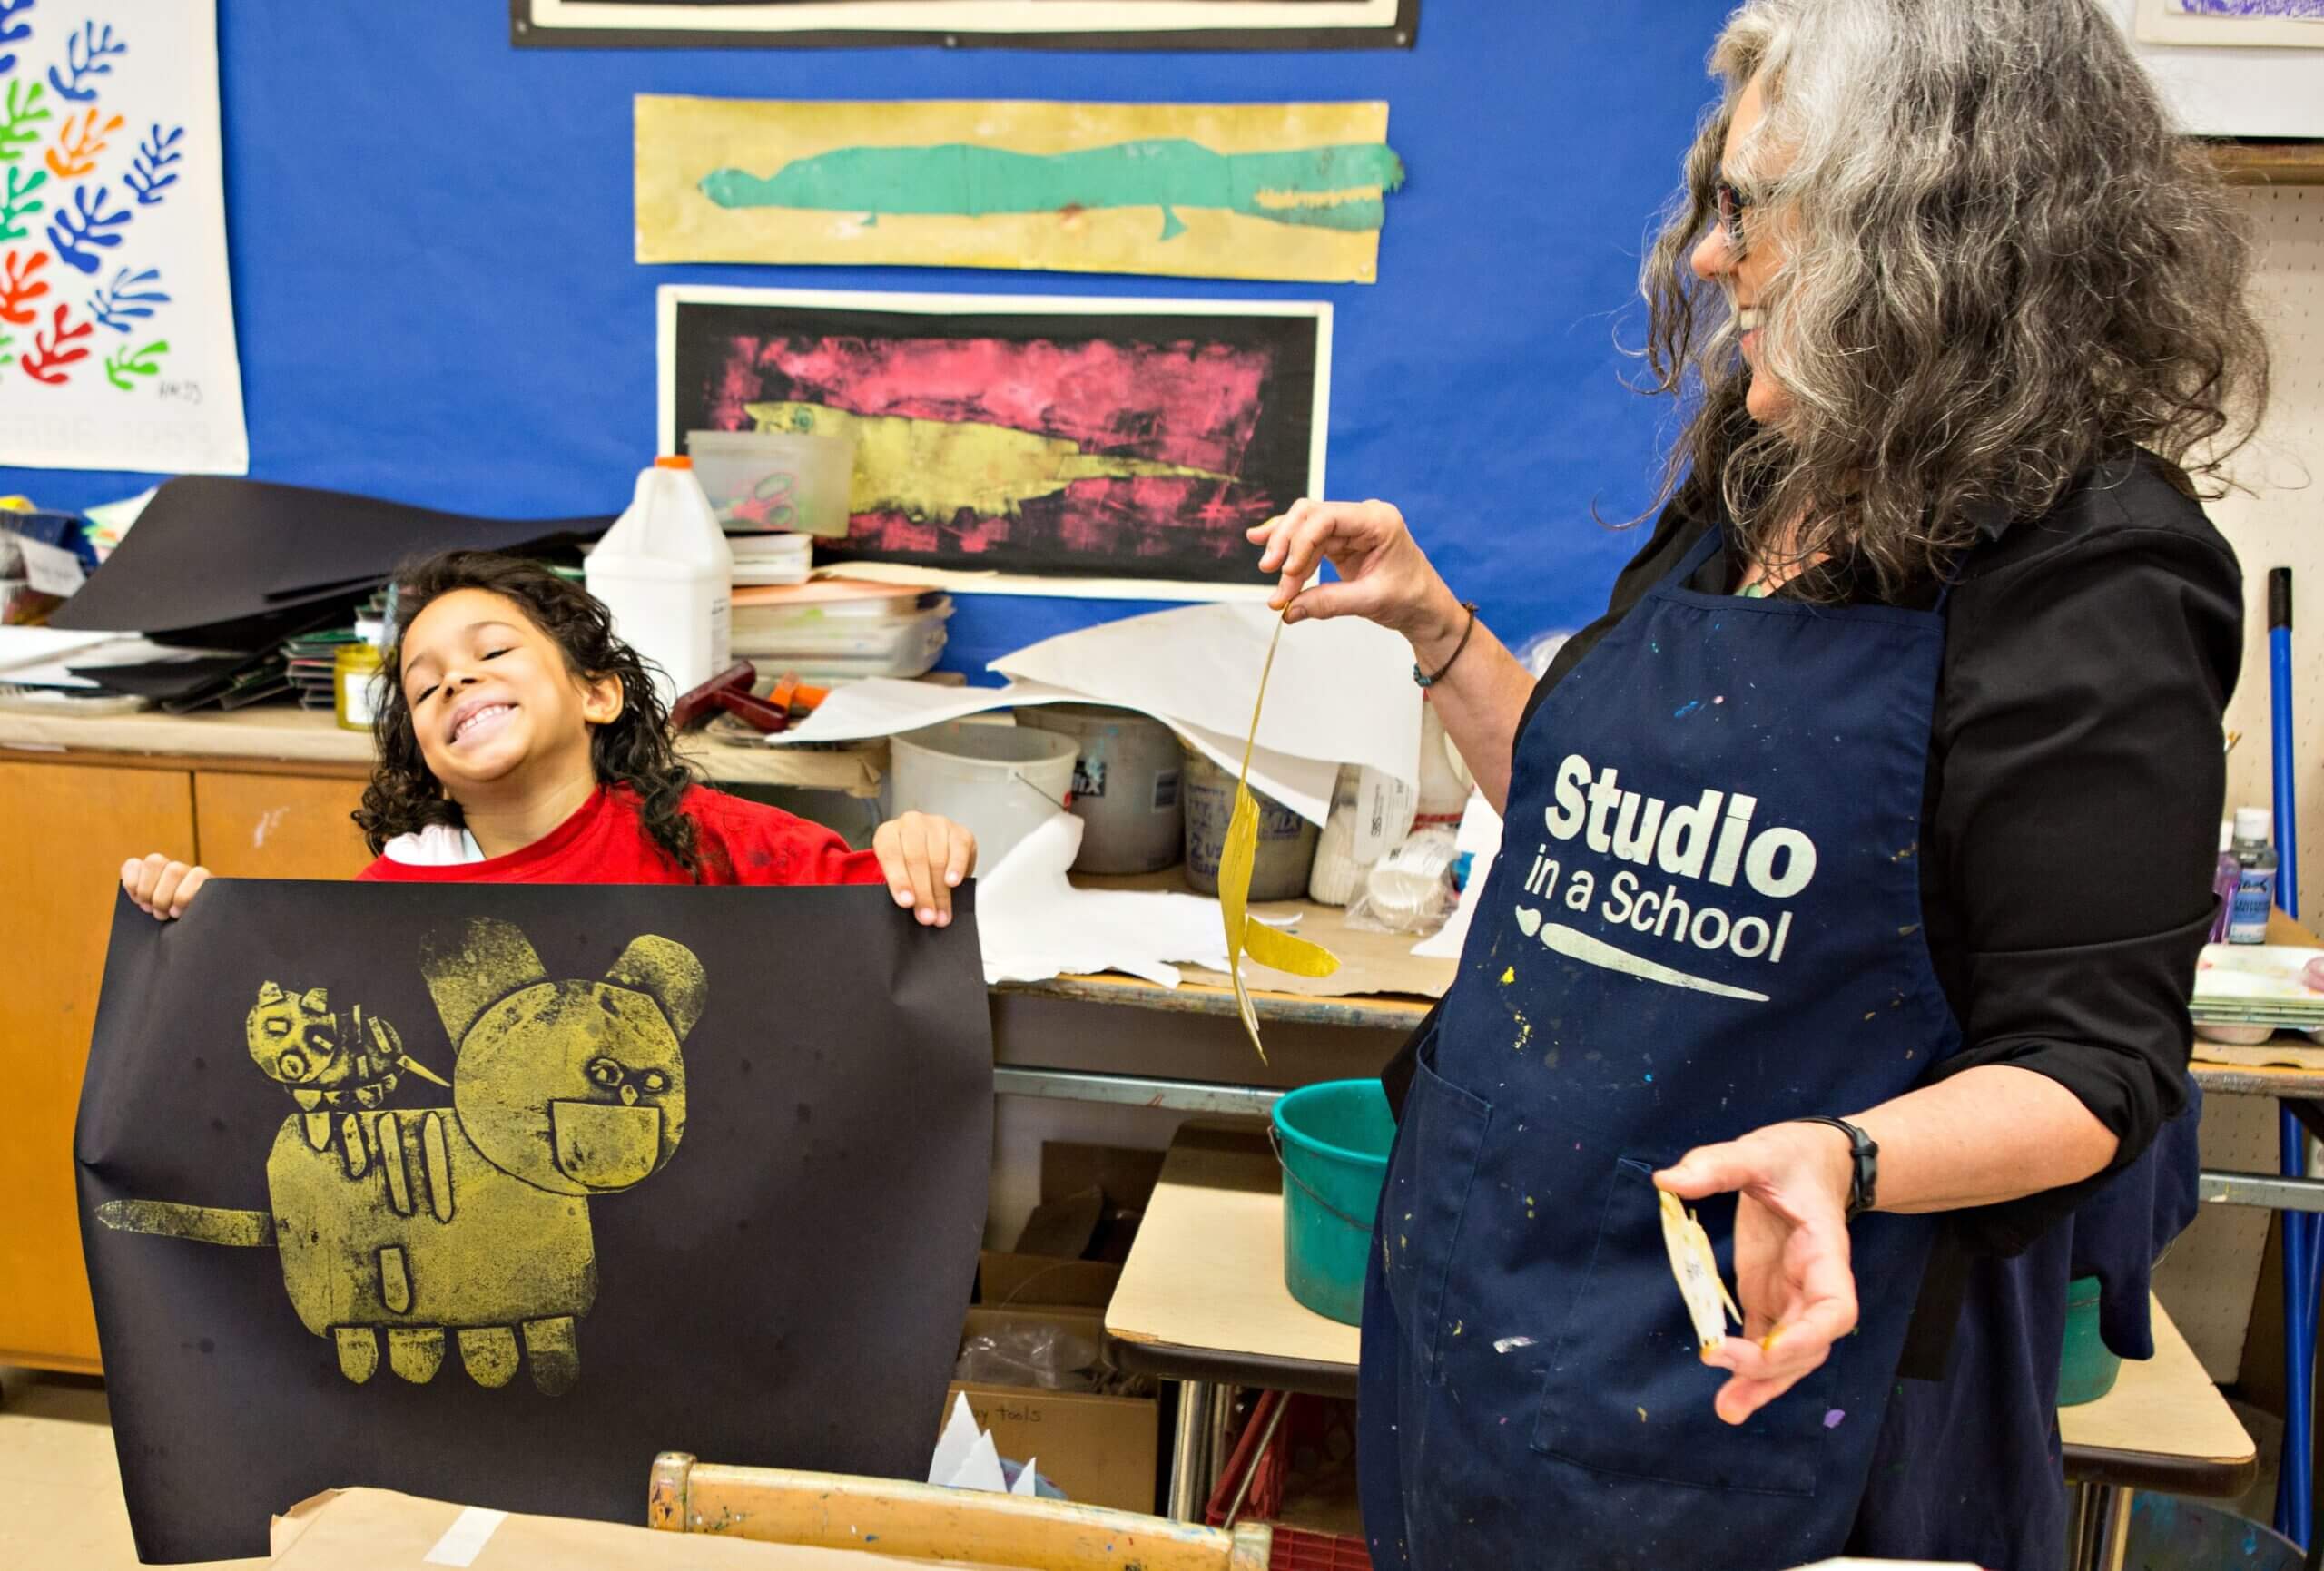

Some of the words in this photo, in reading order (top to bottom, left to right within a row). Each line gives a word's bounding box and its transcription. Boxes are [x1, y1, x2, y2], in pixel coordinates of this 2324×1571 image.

[1544, 753, 1817, 898] Studio
[1523, 843, 1561, 899] in
[1565, 869, 1596, 913] a
[1602, 869, 1794, 964] School
[995, 1404, 1041, 1423] tools
